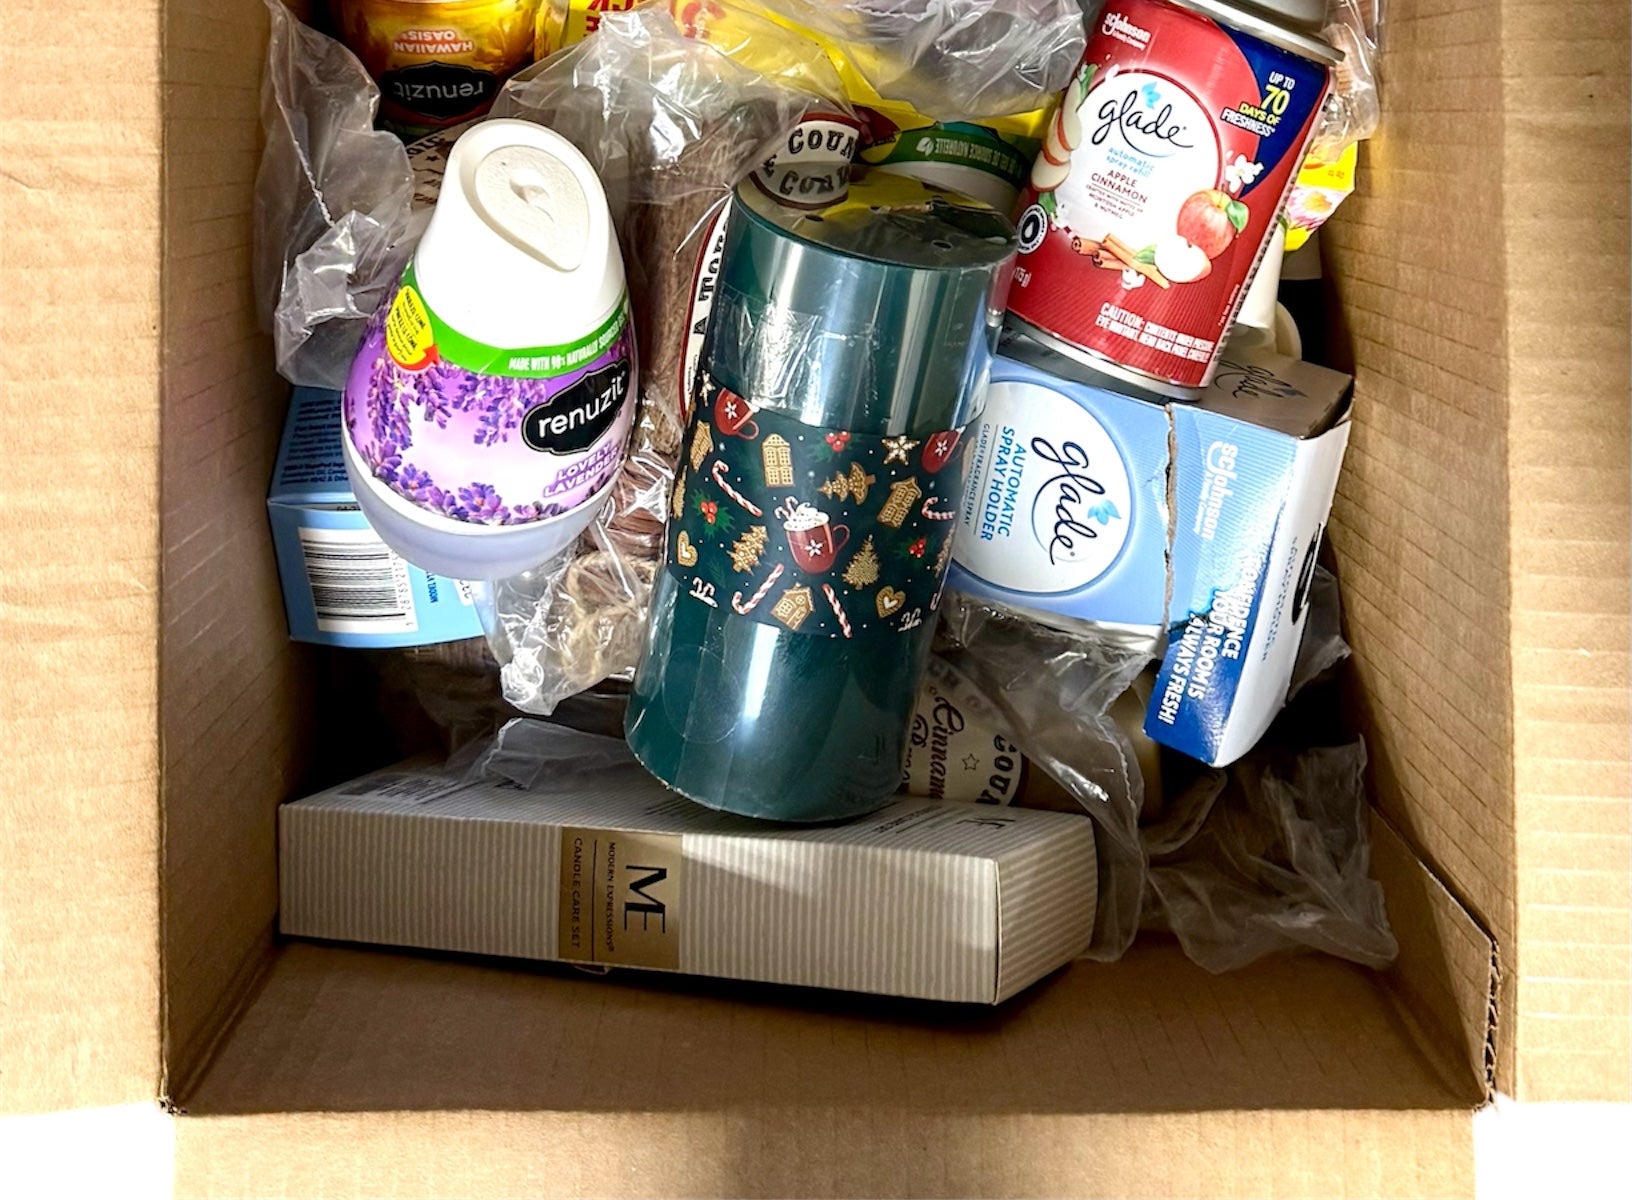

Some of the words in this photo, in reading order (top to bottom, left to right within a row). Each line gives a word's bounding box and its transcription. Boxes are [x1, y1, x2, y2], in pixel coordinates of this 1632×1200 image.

[394, 40, 473, 53] HAWAIIAN
[409, 31, 454, 41] OASIS
[393, 80, 485, 100] renuzit
[1268, 71, 1284, 85] UP
[1283, 76, 1296, 90] TO
[1239, 103, 1267, 121] DAYS
[1266, 114, 1281, 127] OF
[1261, 85, 1291, 116] 70
[1105, 155, 1128, 173] spray
[1108, 146, 1155, 172] automatic
[1090, 172, 1148, 205] CINNAMON
[1107, 169, 1138, 188] APPLE
[1100, 302, 1146, 330] CAUTION:
[531, 356, 550, 371] WITH
[538, 376, 624, 438] renuzit
[558, 442, 612, 481] LOVELY
[994, 426, 1015, 477] SPRAY
[544, 450, 618, 498] LAVENDER
[967, 455, 984, 502] FRAGRANCE
[998, 443, 1027, 538] AUTOMATIC
[964, 503, 973, 527] SPRAY
[981, 480, 1004, 541] HOLDER
[1173, 615, 1201, 675] ALWAYS
[1193, 636, 1218, 684] ROOM
[1158, 674, 1184, 725] FRESH!
[1188, 682, 1206, 700] IS
[572, 837, 583, 886] CANDLE
[607, 842, 616, 881] MODERN
[572, 890, 581, 922] CARE
[624, 864, 667, 934] ME
[572, 926, 580, 948] SET
